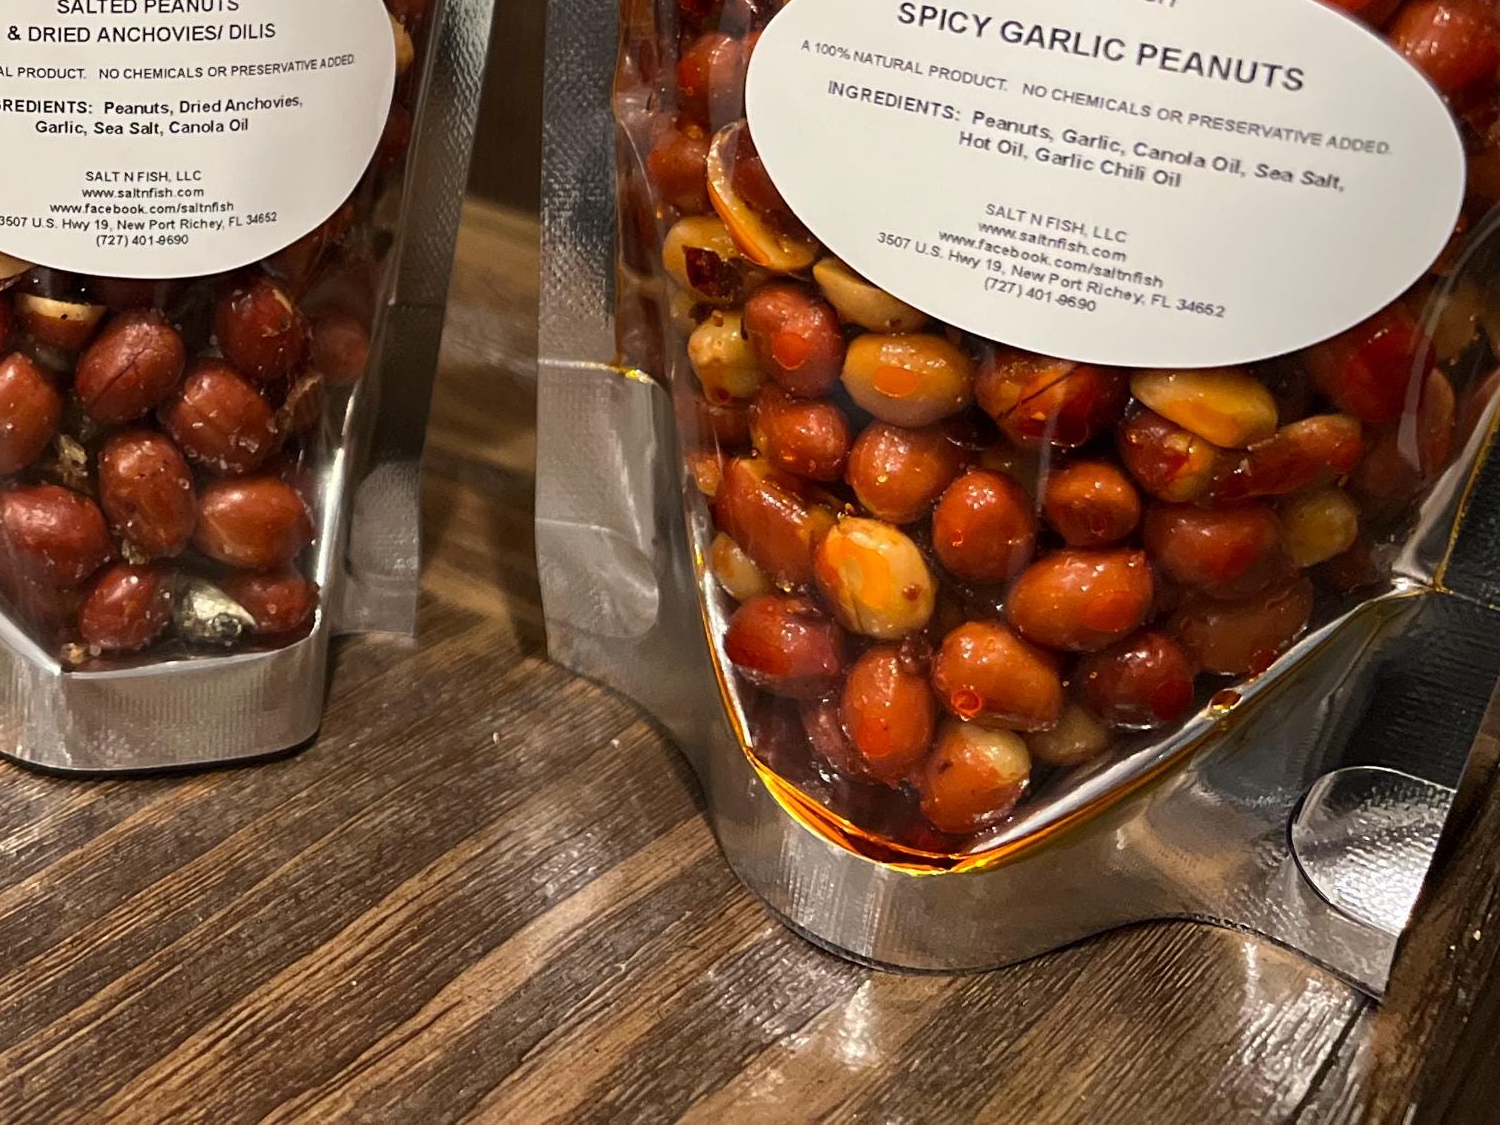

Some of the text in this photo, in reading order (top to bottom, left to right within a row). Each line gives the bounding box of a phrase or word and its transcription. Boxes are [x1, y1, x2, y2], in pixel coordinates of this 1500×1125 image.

[7, 25, 21, 41] &
[28, 26, 90, 42] DRIED
[229, 23, 276, 40] DILIS
[897, 2, 1304, 91] SPICY GARLIC PEANUTS
[17, 67, 86, 79] PRODUCT.
[99, 69, 119, 79] NO
[123, 67, 203, 79] CHEMICALS
[208, 66, 227, 77] OR
[231, 59, 317, 76] PRESERVATIVE
[801, 40, 810, 51] A
[815, 43, 850, 60] 100%
[853, 51, 923, 75] NATURAL
[928, 65, 1008, 91] PRODUCT.
[1022, 83, 1047, 98] NO
[1052, 88, 1151, 117] CHEMICALS
[1157, 108, 1183, 124] OR
[1188, 113, 1322, 146] PRESERVATIVE
[104, 101, 173, 116] Peanuts,
[180, 99, 221, 113] Dried
[225, 95, 303, 112] Anchovies,
[35, 118, 248, 137] Garlic, Sea Salt, Canola Oil
[828, 80, 1344, 192] INGREDIENTS: Peanuts, Garlic, Canola Oil, Sea Salt,
[959, 131, 1182, 187] Hot Oil, Garlic Chili Oil
[86, 170, 201, 183] SALT N FISH, LLC
[82, 187, 204, 198] www.saltnfish.com
[50, 201, 234, 214] www.facebook.com/saltnfish
[32, 217, 57, 228] U.S.
[62, 219, 91, 231] Hwy
[94, 219, 112, 232] 19,
[117, 220, 145, 230] New
[149, 219, 175, 230] Port
[180, 219, 224, 231] Richey,
[229, 216, 242, 227] FL
[246, 212, 277, 225] 34652
[986, 204, 1127, 243] SALT N FISH, LLC
[96, 235, 128, 248] (727)
[978, 223, 1127, 262] www.saltnfish.com
[939, 231, 1163, 288] www.facebook.com/saltnfish
[877, 232, 1225, 317] 3507 U.S. Hwy 19, New Port Richey, FL 34652
[985, 277, 1022, 298] (727)
